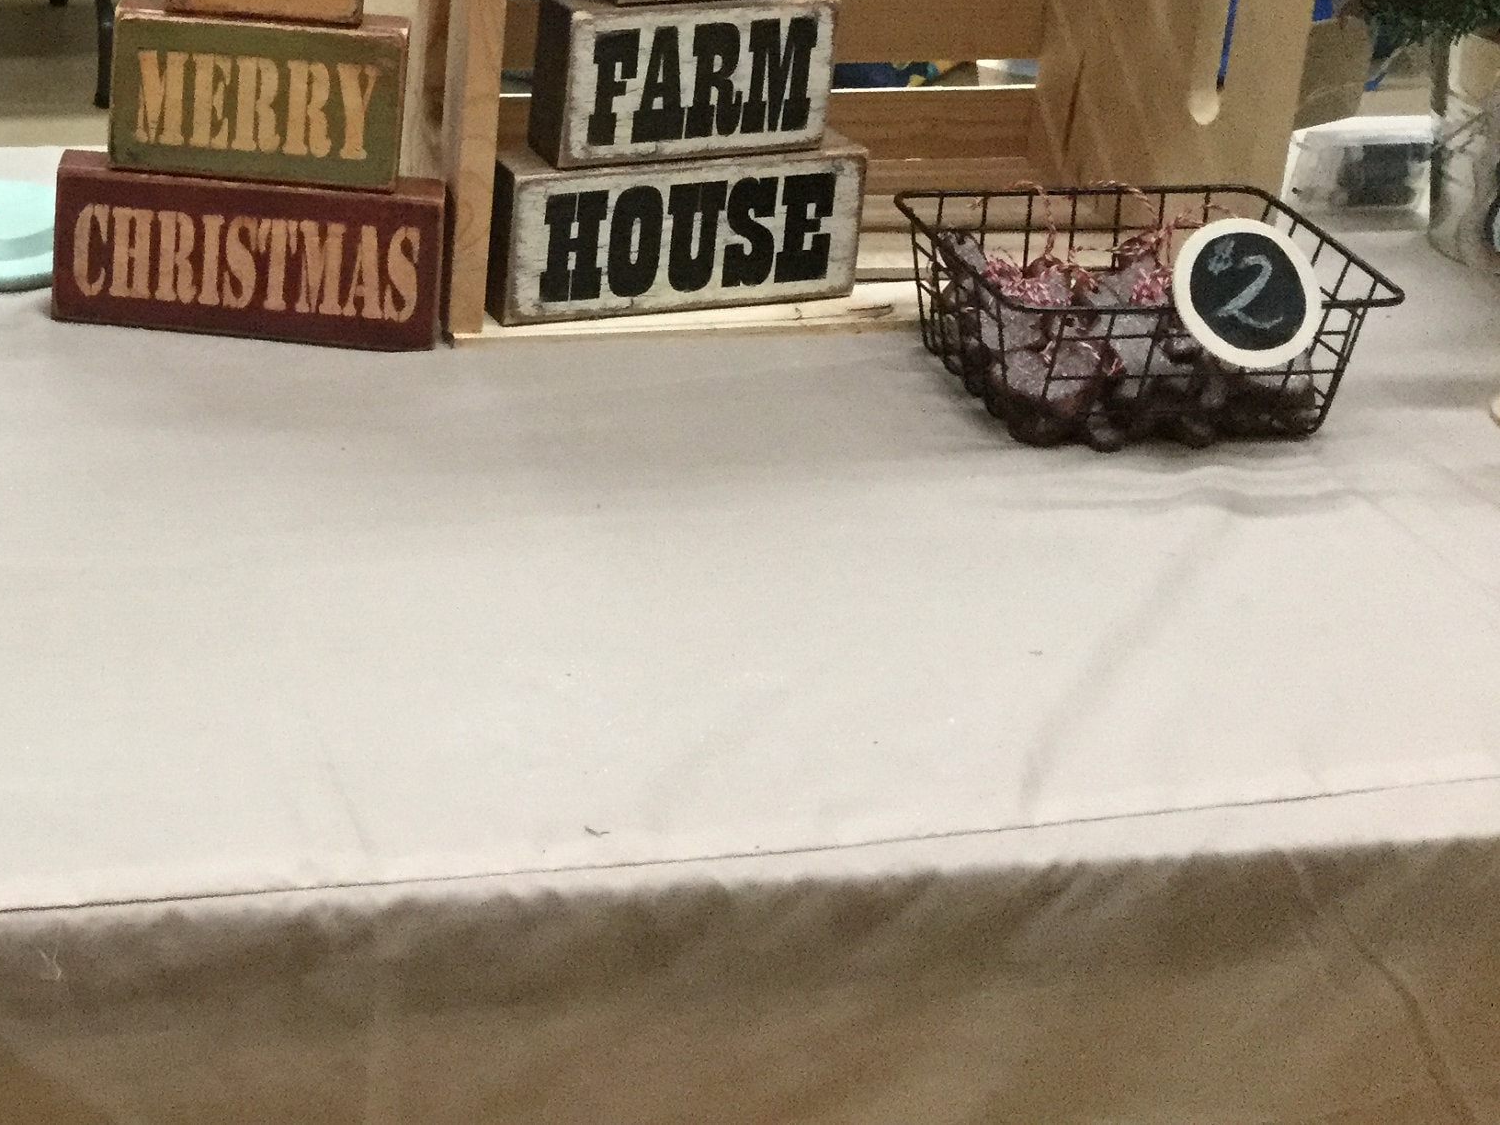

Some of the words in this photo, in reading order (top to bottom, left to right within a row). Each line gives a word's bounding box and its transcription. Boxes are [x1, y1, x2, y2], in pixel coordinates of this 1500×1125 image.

[133, 49, 381, 161] MERRY
[586, 16, 819, 147] FARM
[72, 202, 422, 325] CHRISTMAS
[538, 172, 837, 304] HOUSE
